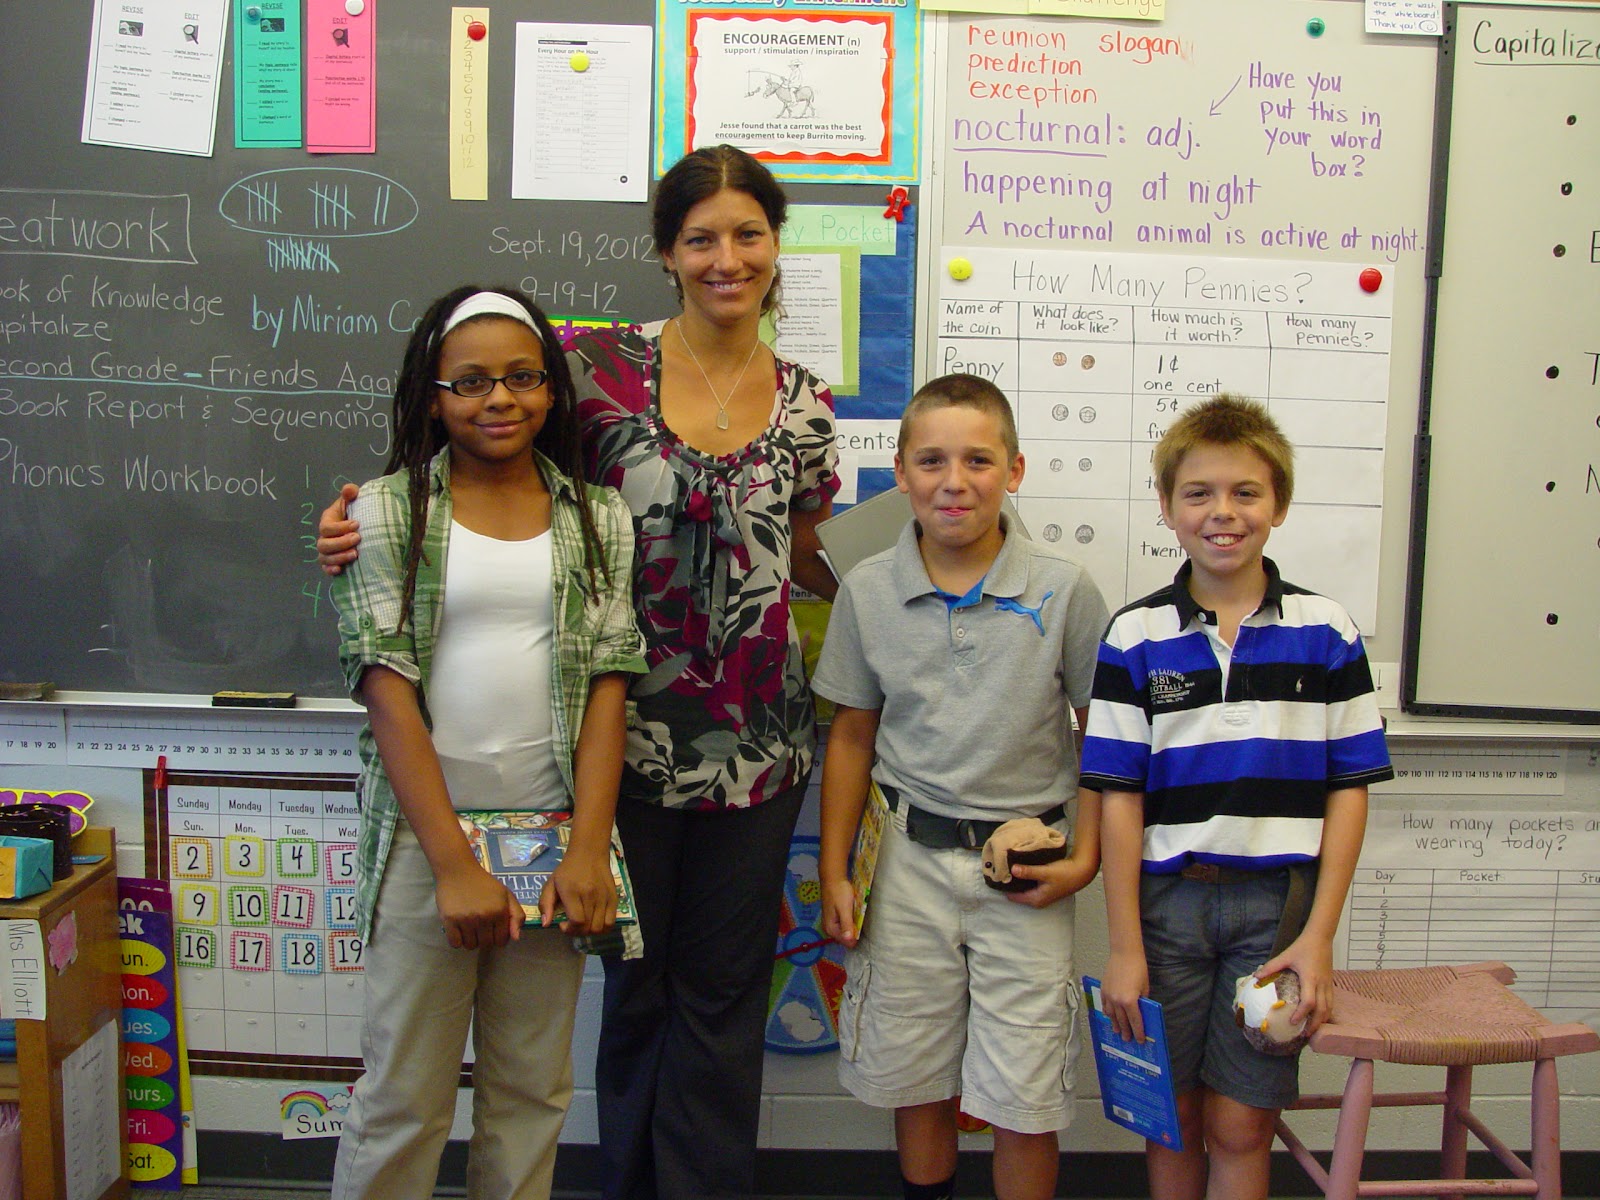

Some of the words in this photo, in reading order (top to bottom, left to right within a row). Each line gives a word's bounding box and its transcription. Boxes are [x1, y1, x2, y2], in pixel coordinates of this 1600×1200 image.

[122, 6, 144, 14] REVISE
[261, 2, 284, 10] REVISE
[184, 13, 200, 21] EDIT
[1370, 18, 1397, 28] Thank
[463, 39, 474, 50] 2
[722, 33, 845, 46] ENCOURAGEMENT
[847, 36, 861, 47] (n)
[968, 25, 1067, 51] reunion
[1098, 30, 1179, 64] slogan
[464, 50, 473, 61] 3
[724, 47, 757, 55] support
[762, 46, 809, 55] stimulation
[815, 47, 859, 56] inspiration
[464, 61, 473, 72] 4
[968, 52, 1083, 82] prediction
[1248, 61, 1296, 89] Have
[1306, 72, 1343, 100] you
[969, 77, 1098, 109] exception
[1260, 98, 1297, 124] put
[1306, 101, 1349, 124] this
[1361, 105, 1382, 128] in
[715, 132, 776, 141] encouragement
[786, 132, 806, 141] keep
[807, 132, 834, 140] Burrito
[835, 133, 867, 141] moving.
[719, 122, 740, 130] Jesse
[742, 121, 765, 130] found
[766, 122, 782, 130] that
[831, 123, 845, 131] the
[845, 123, 862, 131] best
[953, 108, 1127, 146] nocturnal:
[1145, 116, 1201, 161] adj.
[1263, 127, 1312, 156] your
[1330, 129, 1383, 151] word
[1310, 151, 1367, 178] box?
[963, 160, 1113, 214] happening
[1141, 171, 1170, 202] at
[1189, 174, 1262, 221] night
[821, 213, 895, 243] Pocket
[964, 210, 989, 236] A
[1003, 215, 1114, 243] nocturnal
[1136, 221, 1212, 245] animal
[1225, 225, 1247, 246] is
[1260, 221, 1331, 251] active
[1340, 226, 1363, 249] at
[1370, 226, 1427, 263] night.
[488, 226, 552, 261] Sept.
[1012, 259, 1070, 295] How
[1091, 263, 1165, 308] Many
[1184, 266, 1313, 304] Pennies?
[519, 275, 620, 314] 9-19-12
[0, 278, 31, 303] ok
[46, 275, 74, 304] of
[92, 275, 225, 326] Knowledge
[251, 293, 285, 349] by
[292, 293, 378, 336] Miriam
[945, 302, 985, 315] Name
[989, 301, 1004, 314] of
[1032, 304, 1068, 319] What
[1071, 305, 1104, 320] does
[1151, 308, 1180, 324] How
[1184, 310, 1226, 326] much
[1229, 312, 1243, 327] is
[0, 310, 112, 344] pitalize
[943, 320, 964, 334] the
[969, 321, 1002, 336] coin
[1035, 317, 1045, 330] it
[1060, 318, 1086, 332] look
[1089, 317, 1119, 334] like?
[1164, 326, 1178, 341] it
[1188, 326, 1244, 342] worth?
[1286, 313, 1313, 329] How
[1321, 317, 1357, 336] many
[943, 346, 1005, 384] Penny
[1143, 379, 1174, 392] one
[1186, 378, 1223, 393] cent
[0, 388, 70, 417] Book
[87, 390, 187, 429] Report
[231, 396, 391, 456] Sequencing
[835, 430, 896, 451] cents
[124, 454, 278, 501] Workbook
[300, 501, 315, 526] 2
[1140, 540, 1191, 559] twent
[301, 580, 323, 619] 4
[790, 586, 812, 598] tens
[6, 740, 14, 748] 17
[34, 741, 43, 749] 19
[176, 797, 210, 811] Sunday
[228, 800, 263, 812] Monday
[279, 801, 316, 815] Tuesday
[183, 820, 205, 832] Sun.
[234, 822, 257, 833] Mon.
[285, 824, 309, 836] Tues.
[338, 826, 360, 837] Wed.
[1402, 813, 1434, 830] How
[1449, 818, 1494, 839] many
[1508, 816, 1576, 838] pockets
[1414, 837, 1484, 858] wearing
[1501, 834, 1568, 860] today?
[187, 846, 199, 871] 2
[239, 844, 251, 868] 3
[291, 845, 303, 870] 4
[340, 851, 354, 877] 5
[1375, 870, 1396, 883] Day
[1459, 870, 1501, 882] Pocket
[192, 892, 207, 917] 9
[235, 894, 263, 919] 10
[280, 893, 304, 920] 11
[8, 922, 36, 951] Mrs
[184, 934, 210, 960] 16
[239, 939, 263, 964] 17
[291, 940, 316, 966] 18
[337, 939, 361, 964] 19
[11, 957, 39, 1017] Elliott
